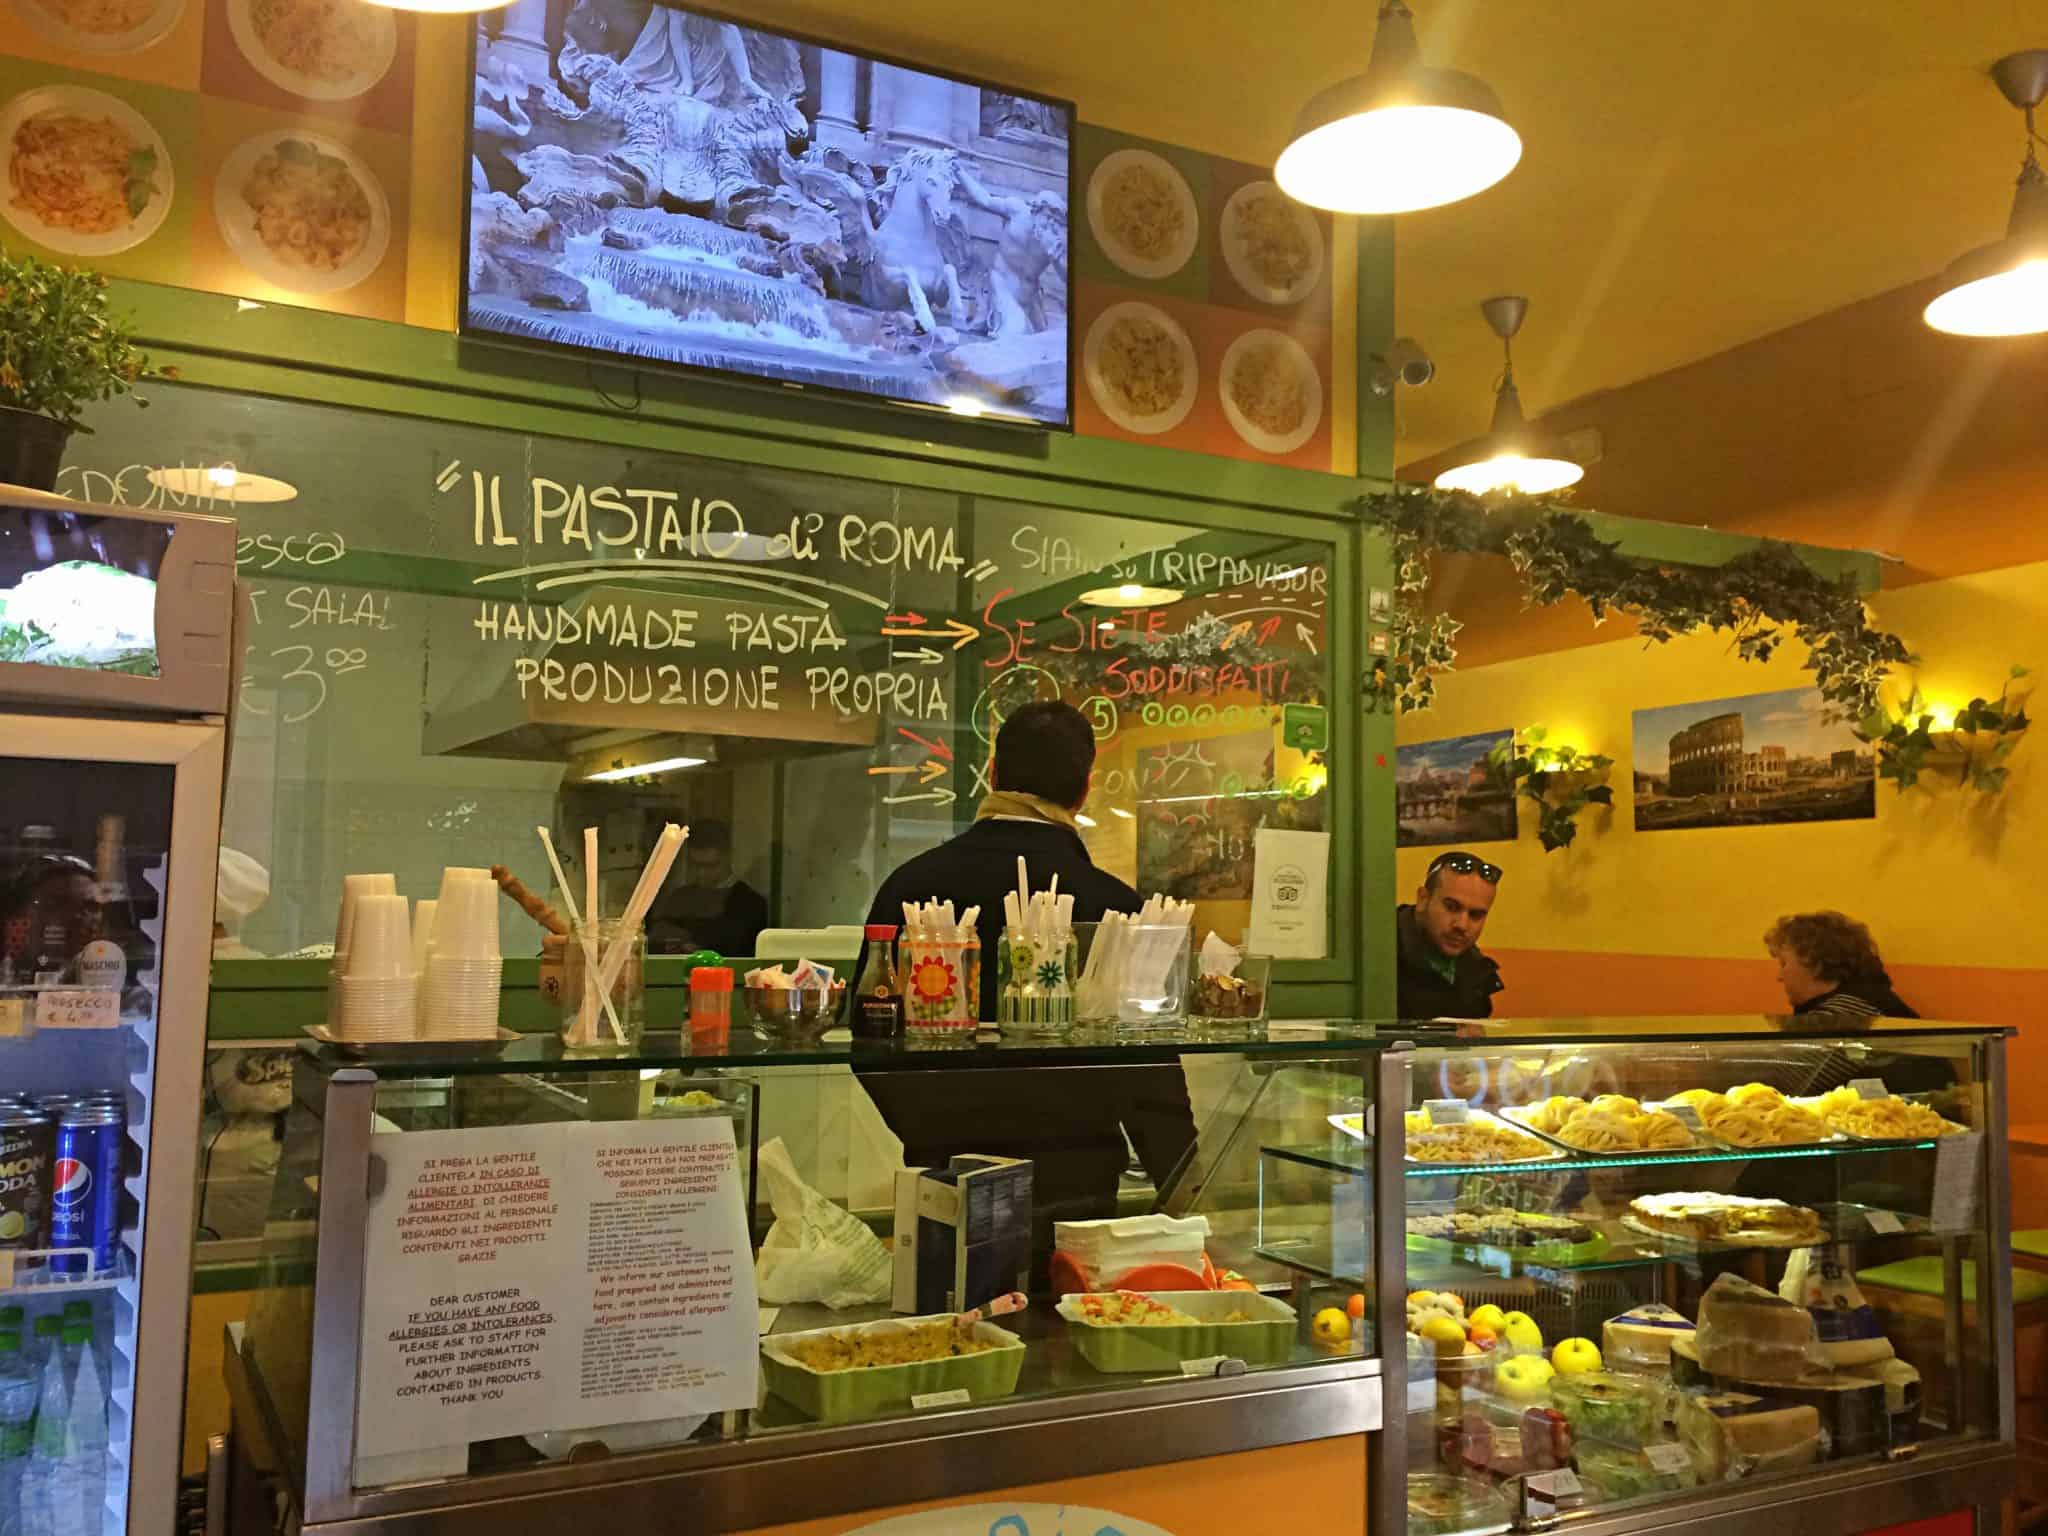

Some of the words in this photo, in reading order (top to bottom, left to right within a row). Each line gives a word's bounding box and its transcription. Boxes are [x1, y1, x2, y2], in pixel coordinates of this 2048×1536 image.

[532, 477, 744, 561] PASTAIO
[1149, 550, 1327, 596] TRIPADVISOR
[474, 603, 698, 649] HANDMADE
[726, 611, 847, 654] PASTA
[984, 589, 1035, 667] SE
[515, 658, 780, 711] PRODUZIONE
[807, 667, 947, 721] PROPRIA
[493, 1152, 536, 1164] GENTILE
[418, 1172, 475, 1183] CLIENTELA
[480, 1170, 494, 1180] IN
[497, 1168, 524, 1178] CASO
[529, 1166, 540, 1176] DI
[408, 1186, 457, 1199] ALLERGIE
[473, 1178, 550, 1194] INTOLLERANZE
[408, 1199, 474, 1213] ALIMENTARI
[499, 1191, 549, 1205] CHIEDERE
[397, 1211, 480, 1226] INFORMAZIONI
[500, 1204, 558, 1217] PERSONALE
[401, 1227, 457, 1240] RIGUARDO
[483, 1218, 552, 1233] INGREDIENTI
[403, 1239, 466, 1254] CONTENUTI
[471, 1238, 489, 1249] NEI
[494, 1233, 546, 1245] PRODOTTI
[458, 1250, 496, 1263] GRAZIE
[714, 1264, 731, 1273] that
[430, 1295, 458, 1306] DEAR
[463, 1288, 520, 1304] CUSTOMER
[408, 1314, 419, 1324] IF
[424, 1311, 448, 1322] YOU
[452, 1307, 480, 1319] HAVE
[486, 1304, 506, 1314] ANY
[511, 1300, 540, 1312] FOOD
[388, 1325, 449, 1341] ALLERGIES
[453, 1323, 467, 1334] OR
[399, 1340, 439, 1353] PLEASE
[444, 1337, 465, 1348] ASK
[470, 1335, 484, 1345] TO
[488, 1329, 521, 1343] STAFF
[526, 1328, 546, 1338] FOR
[405, 1352, 455, 1367] FURTHER
[460, 1343, 540, 1361] INFORMATION
[414, 1367, 452, 1380] ABOUT
[456, 1358, 531, 1375] INGREDIENTS
[396, 1379, 464, 1397] CONTAINED
[468, 1378, 482, 1388] IN
[440, 1392, 478, 1406] THANK
[482, 1390, 504, 1400] YOU
